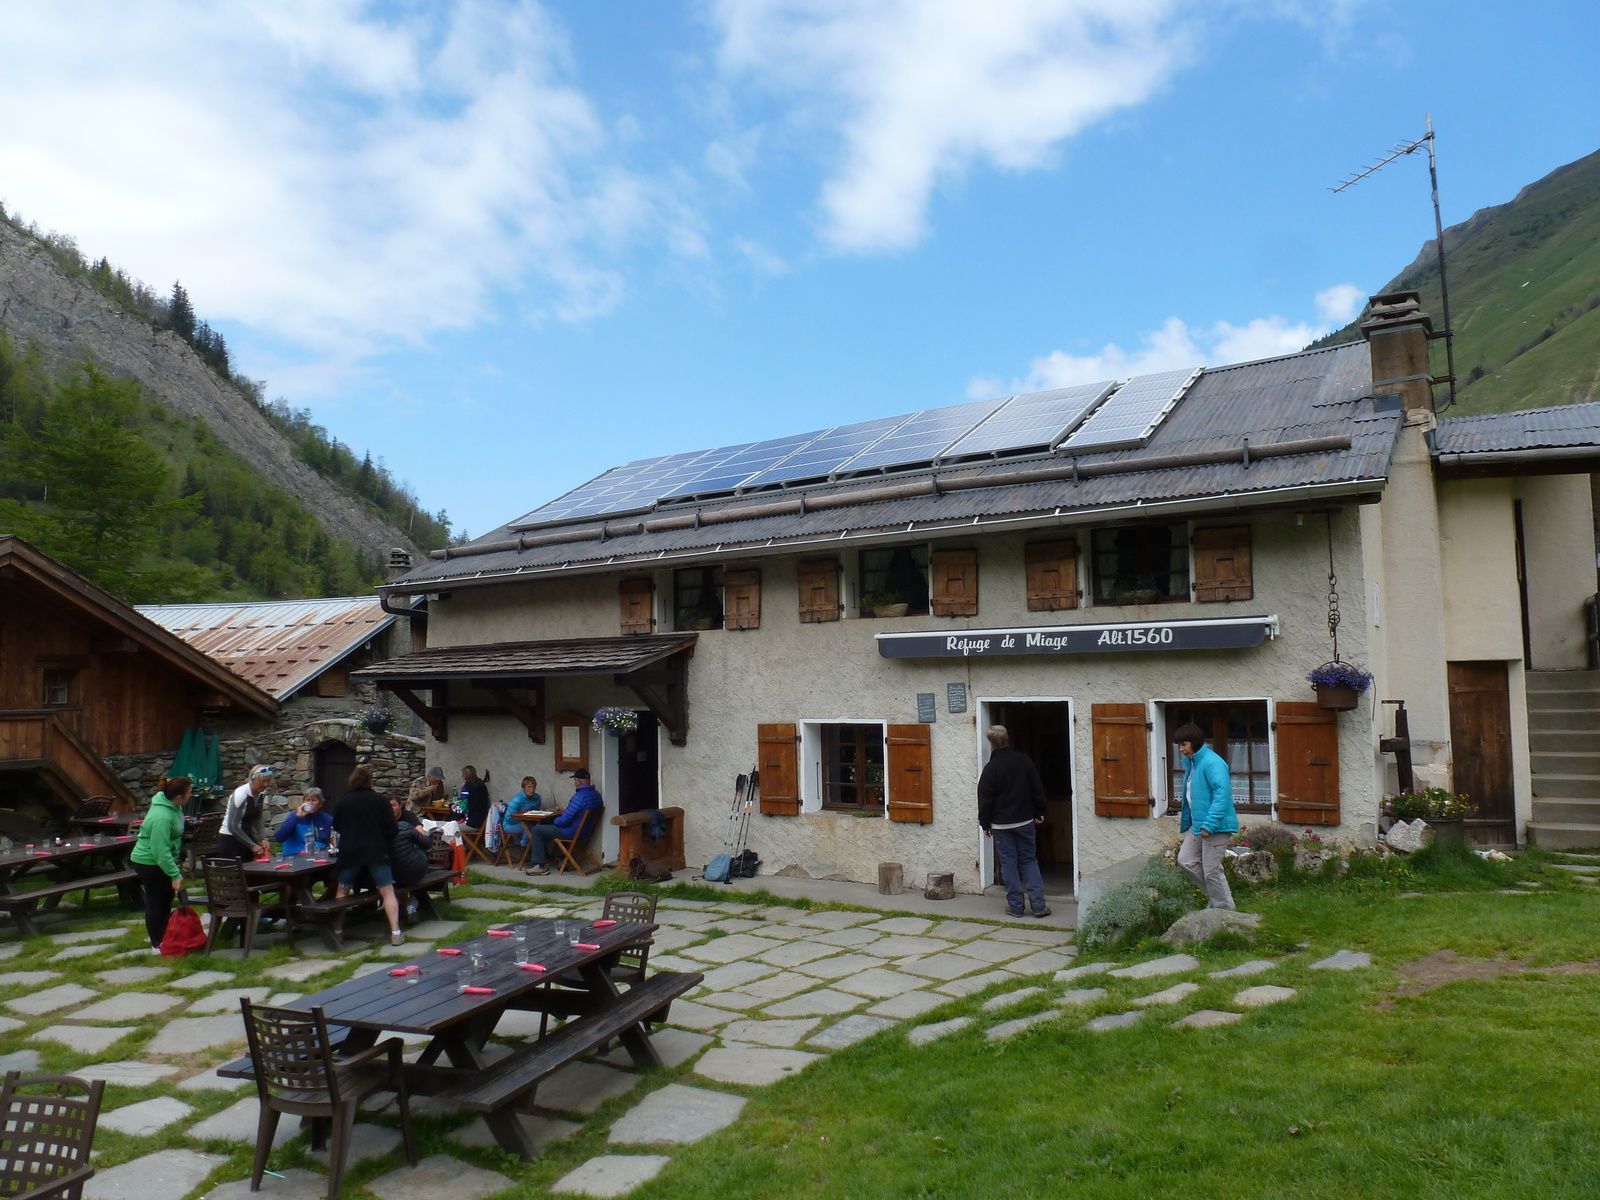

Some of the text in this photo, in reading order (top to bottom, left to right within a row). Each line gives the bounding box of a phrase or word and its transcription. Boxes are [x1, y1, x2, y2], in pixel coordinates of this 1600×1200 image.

[946, 635, 990, 656] Refuge
[1000, 635, 1015, 648] de
[1025, 632, 1068, 651] Miage
